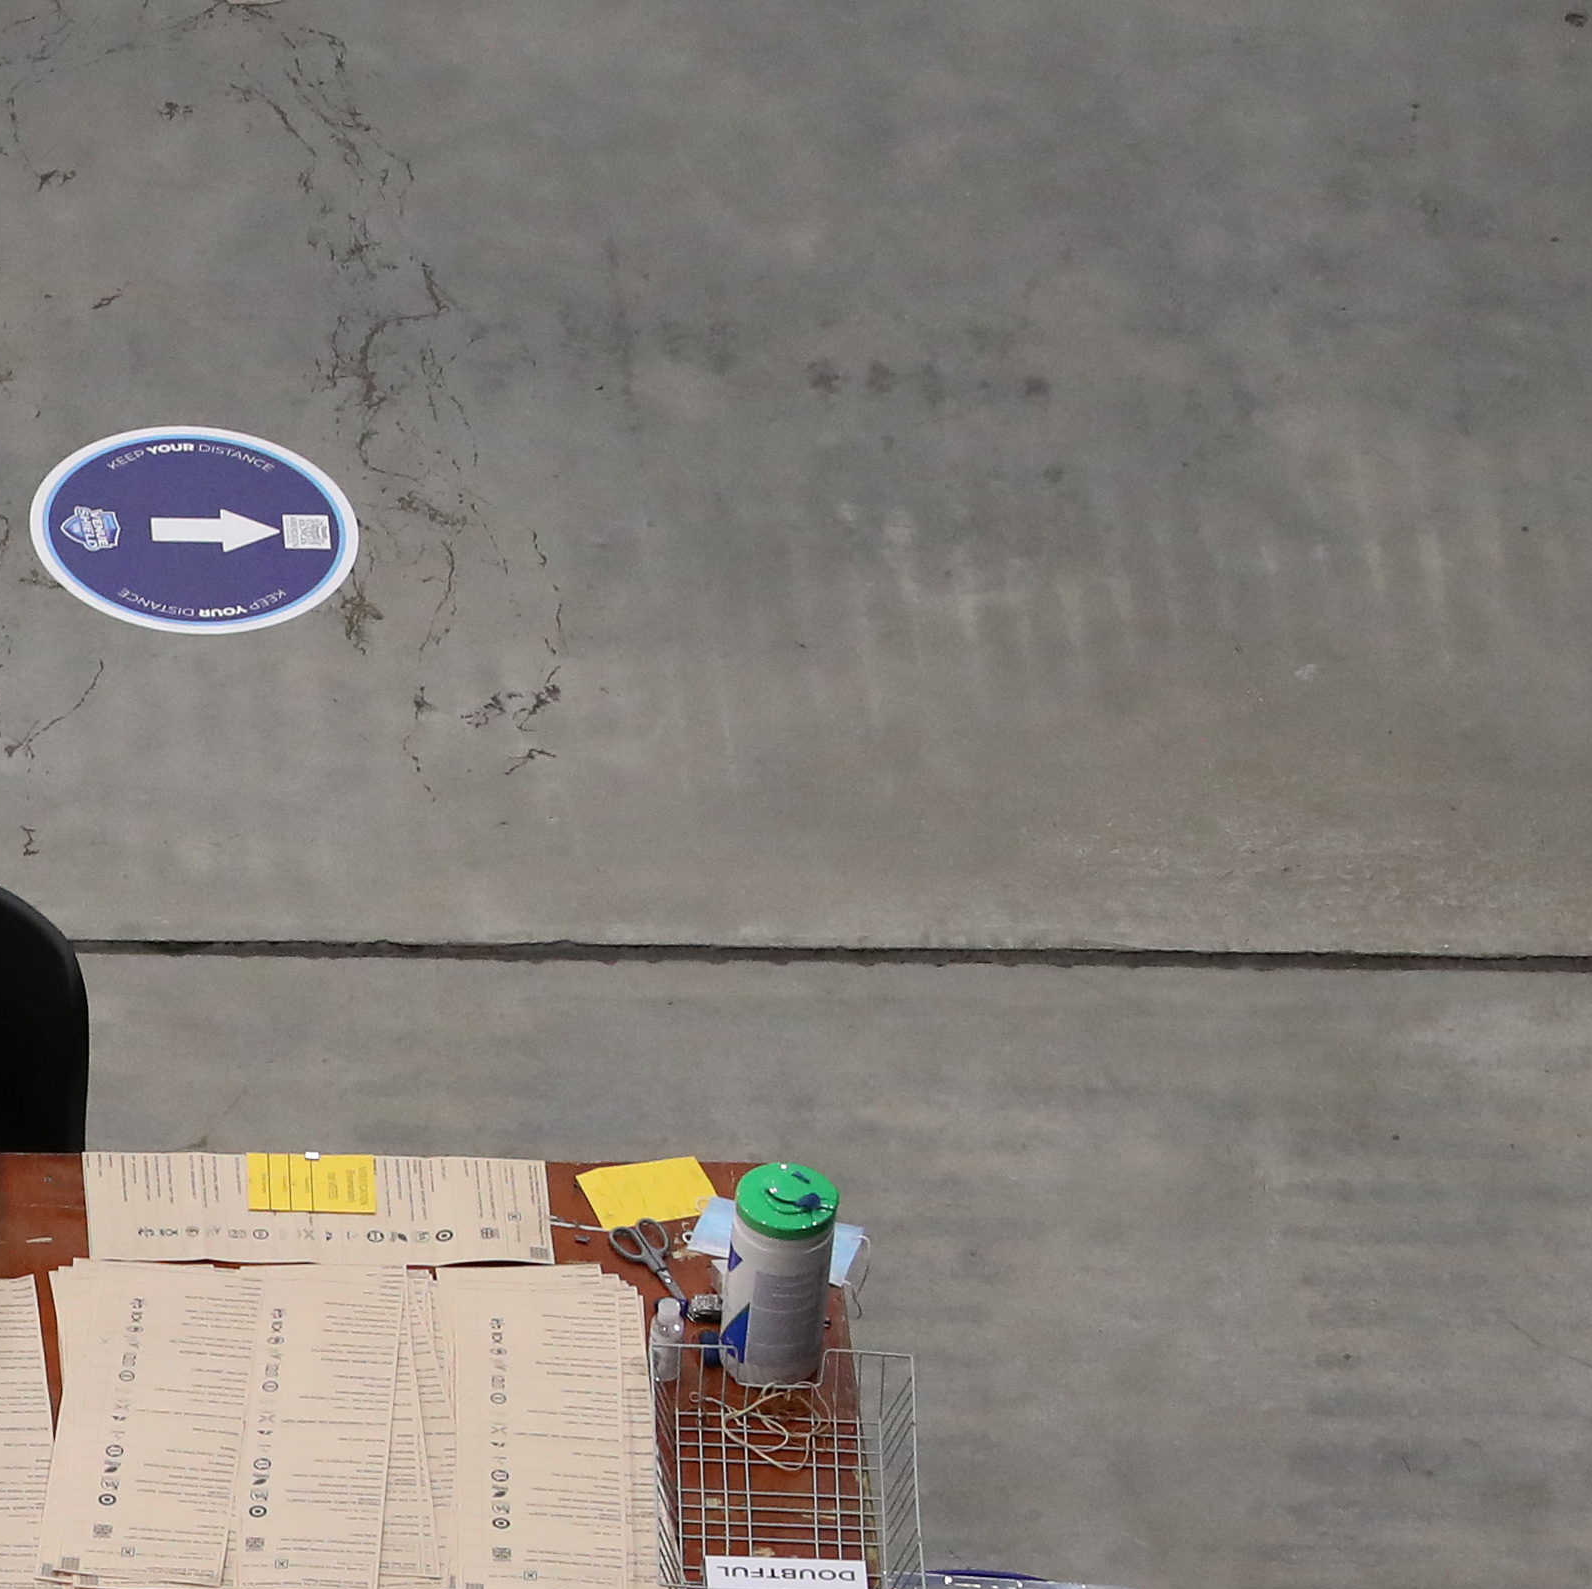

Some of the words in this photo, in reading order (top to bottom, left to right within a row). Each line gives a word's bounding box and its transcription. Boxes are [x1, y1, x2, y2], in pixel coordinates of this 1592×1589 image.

[107, 450, 146, 471] KEEP
[146, 443, 195, 455] YOUR
[199, 443, 276, 473] DISTANCE
[117, 587, 195, 617] DISTANCE
[250, 588, 287, 610] KEEP
[198, 604, 248, 618] YOUR
[717, 1565, 856, 1582] DOUBTFUL
